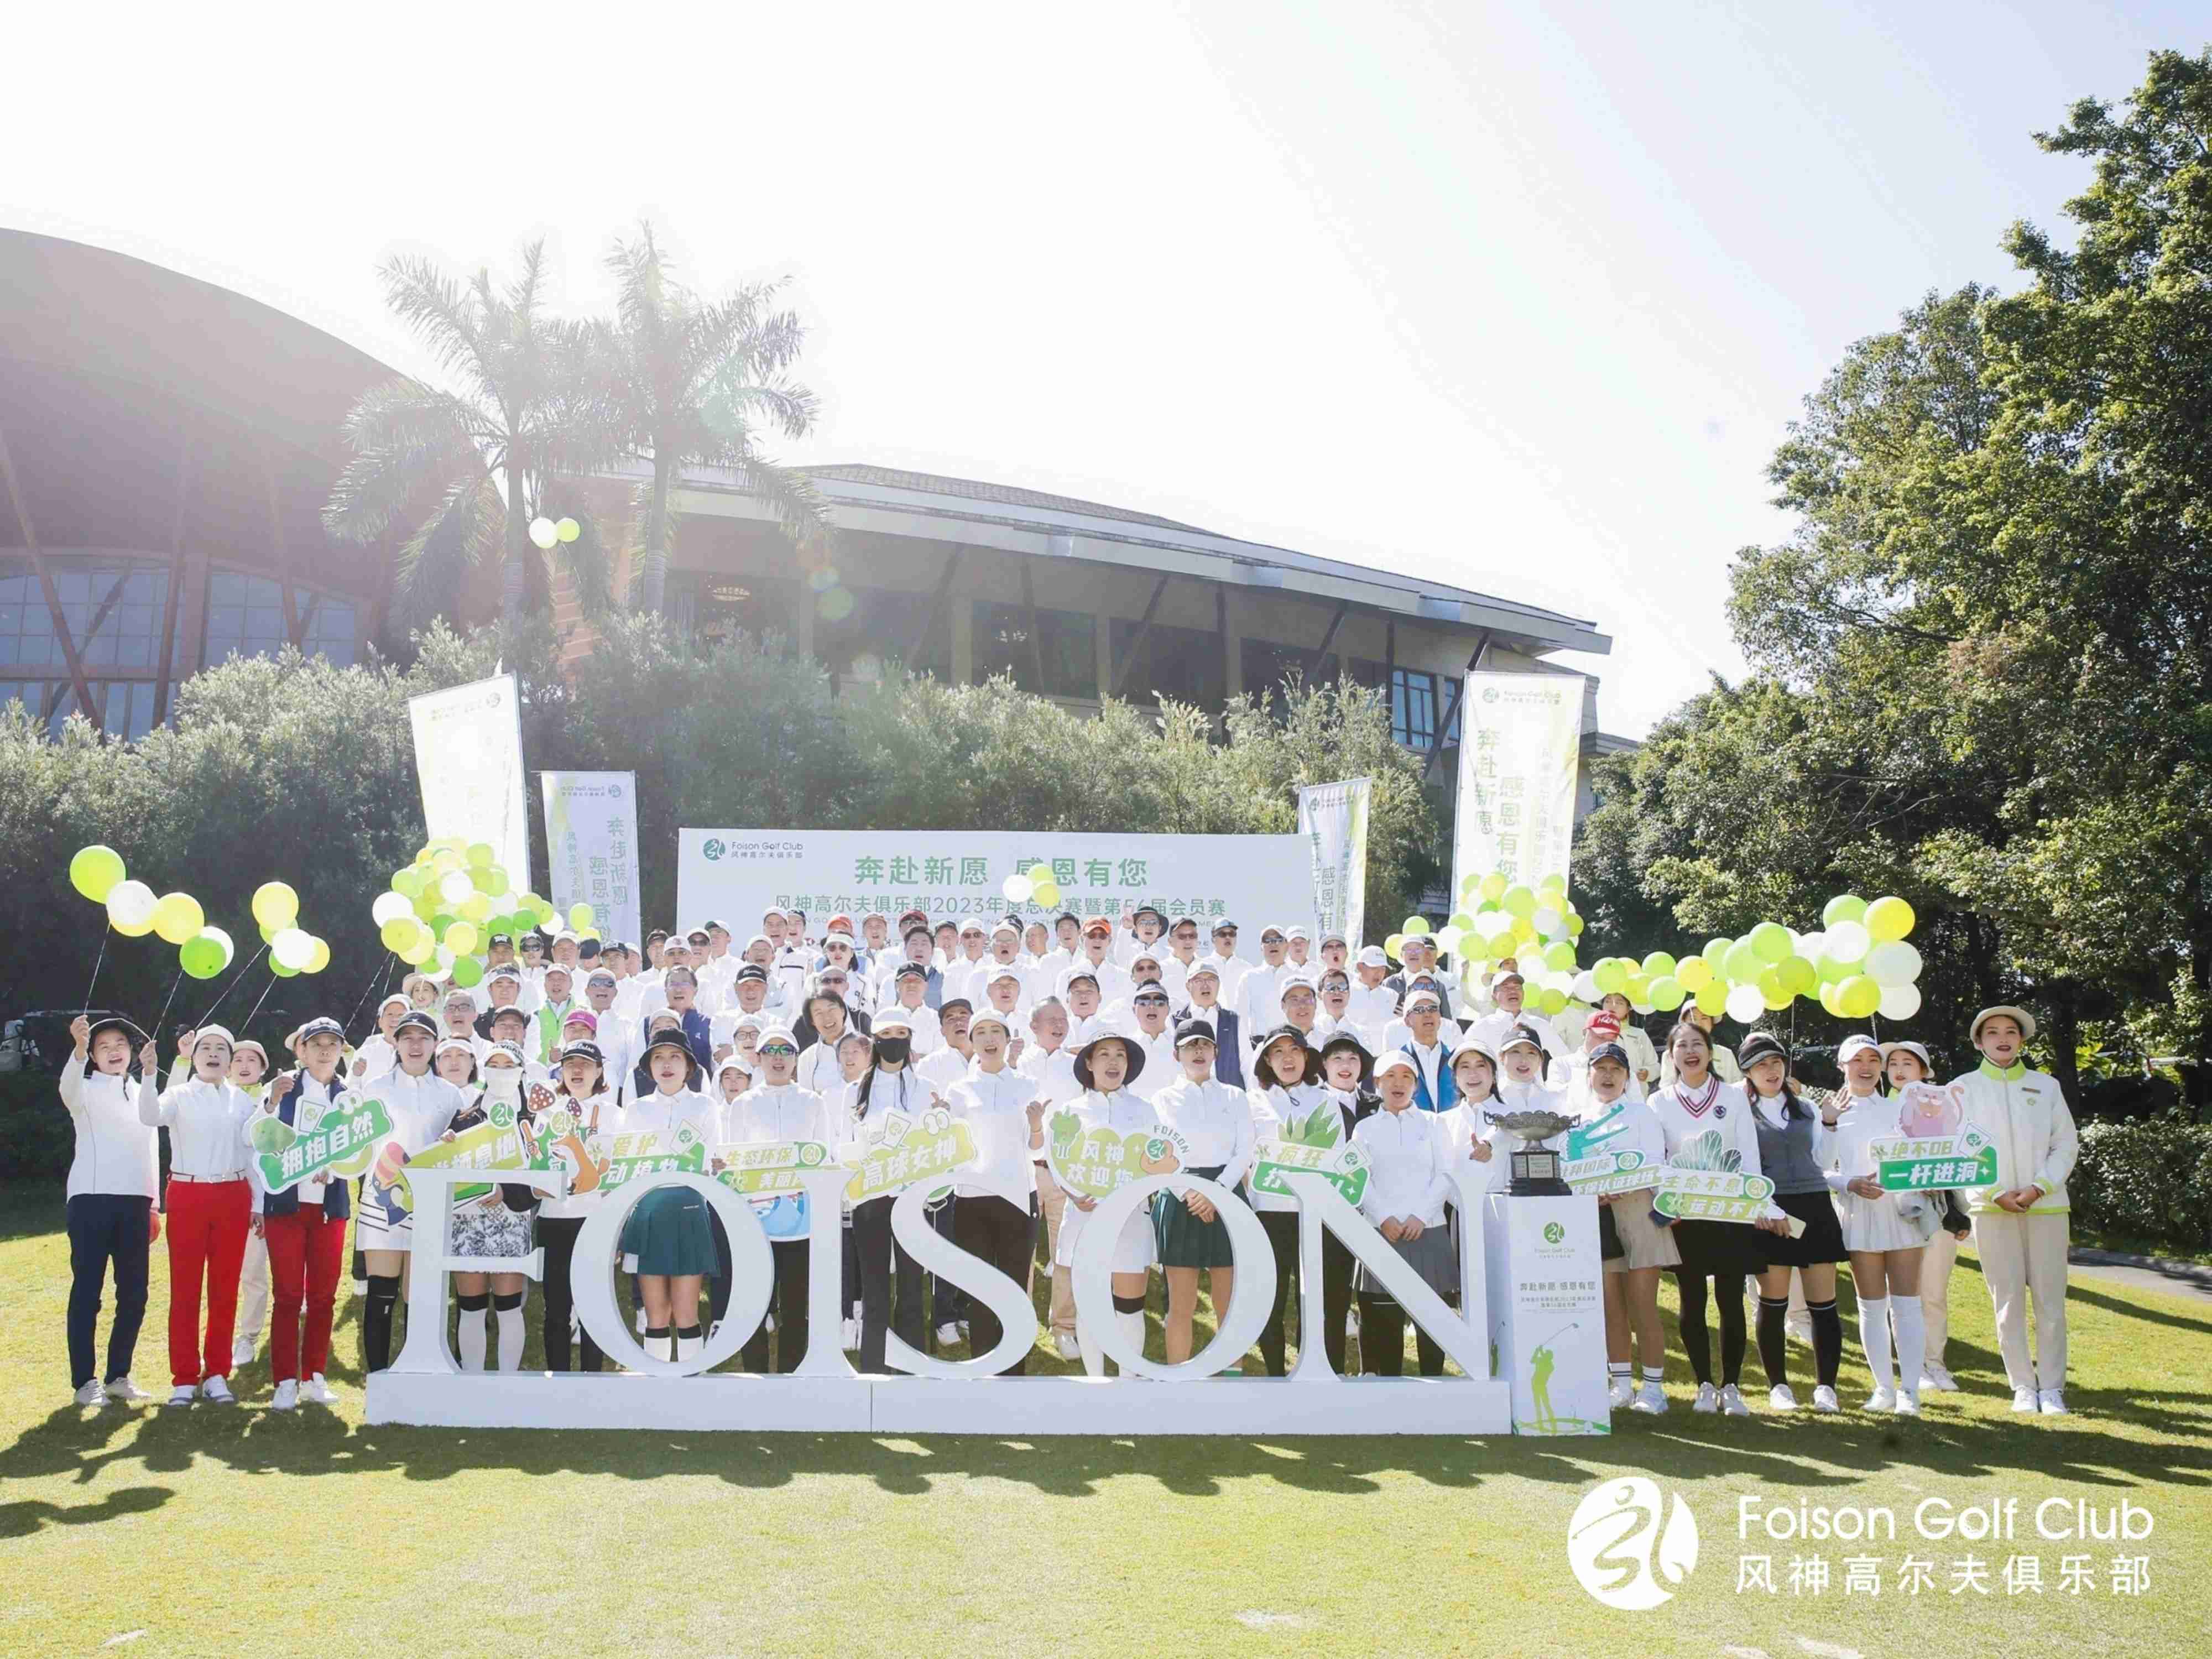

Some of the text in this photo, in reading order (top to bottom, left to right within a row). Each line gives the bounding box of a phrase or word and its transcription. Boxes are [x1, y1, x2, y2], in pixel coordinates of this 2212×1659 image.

[732, 842, 804, 850] Foison Golf Club
[854, 856, 989, 885] 奔赴新愿
[283, 1110, 374, 1179] 拥抱自然
[433, 1133, 517, 1168] 栖息地
[726, 1147, 792, 1165] 生态环保
[1083, 1139, 1124, 1164] 风神
[1277, 1144, 1326, 1167] 疯狂
[606, 1158, 679, 1185] 动植物
[863, 1135, 957, 1191] 高球女神
[1888, 1161, 1978, 1185] 一杆进洞
[387, 1167, 1490, 1380] FOISON
